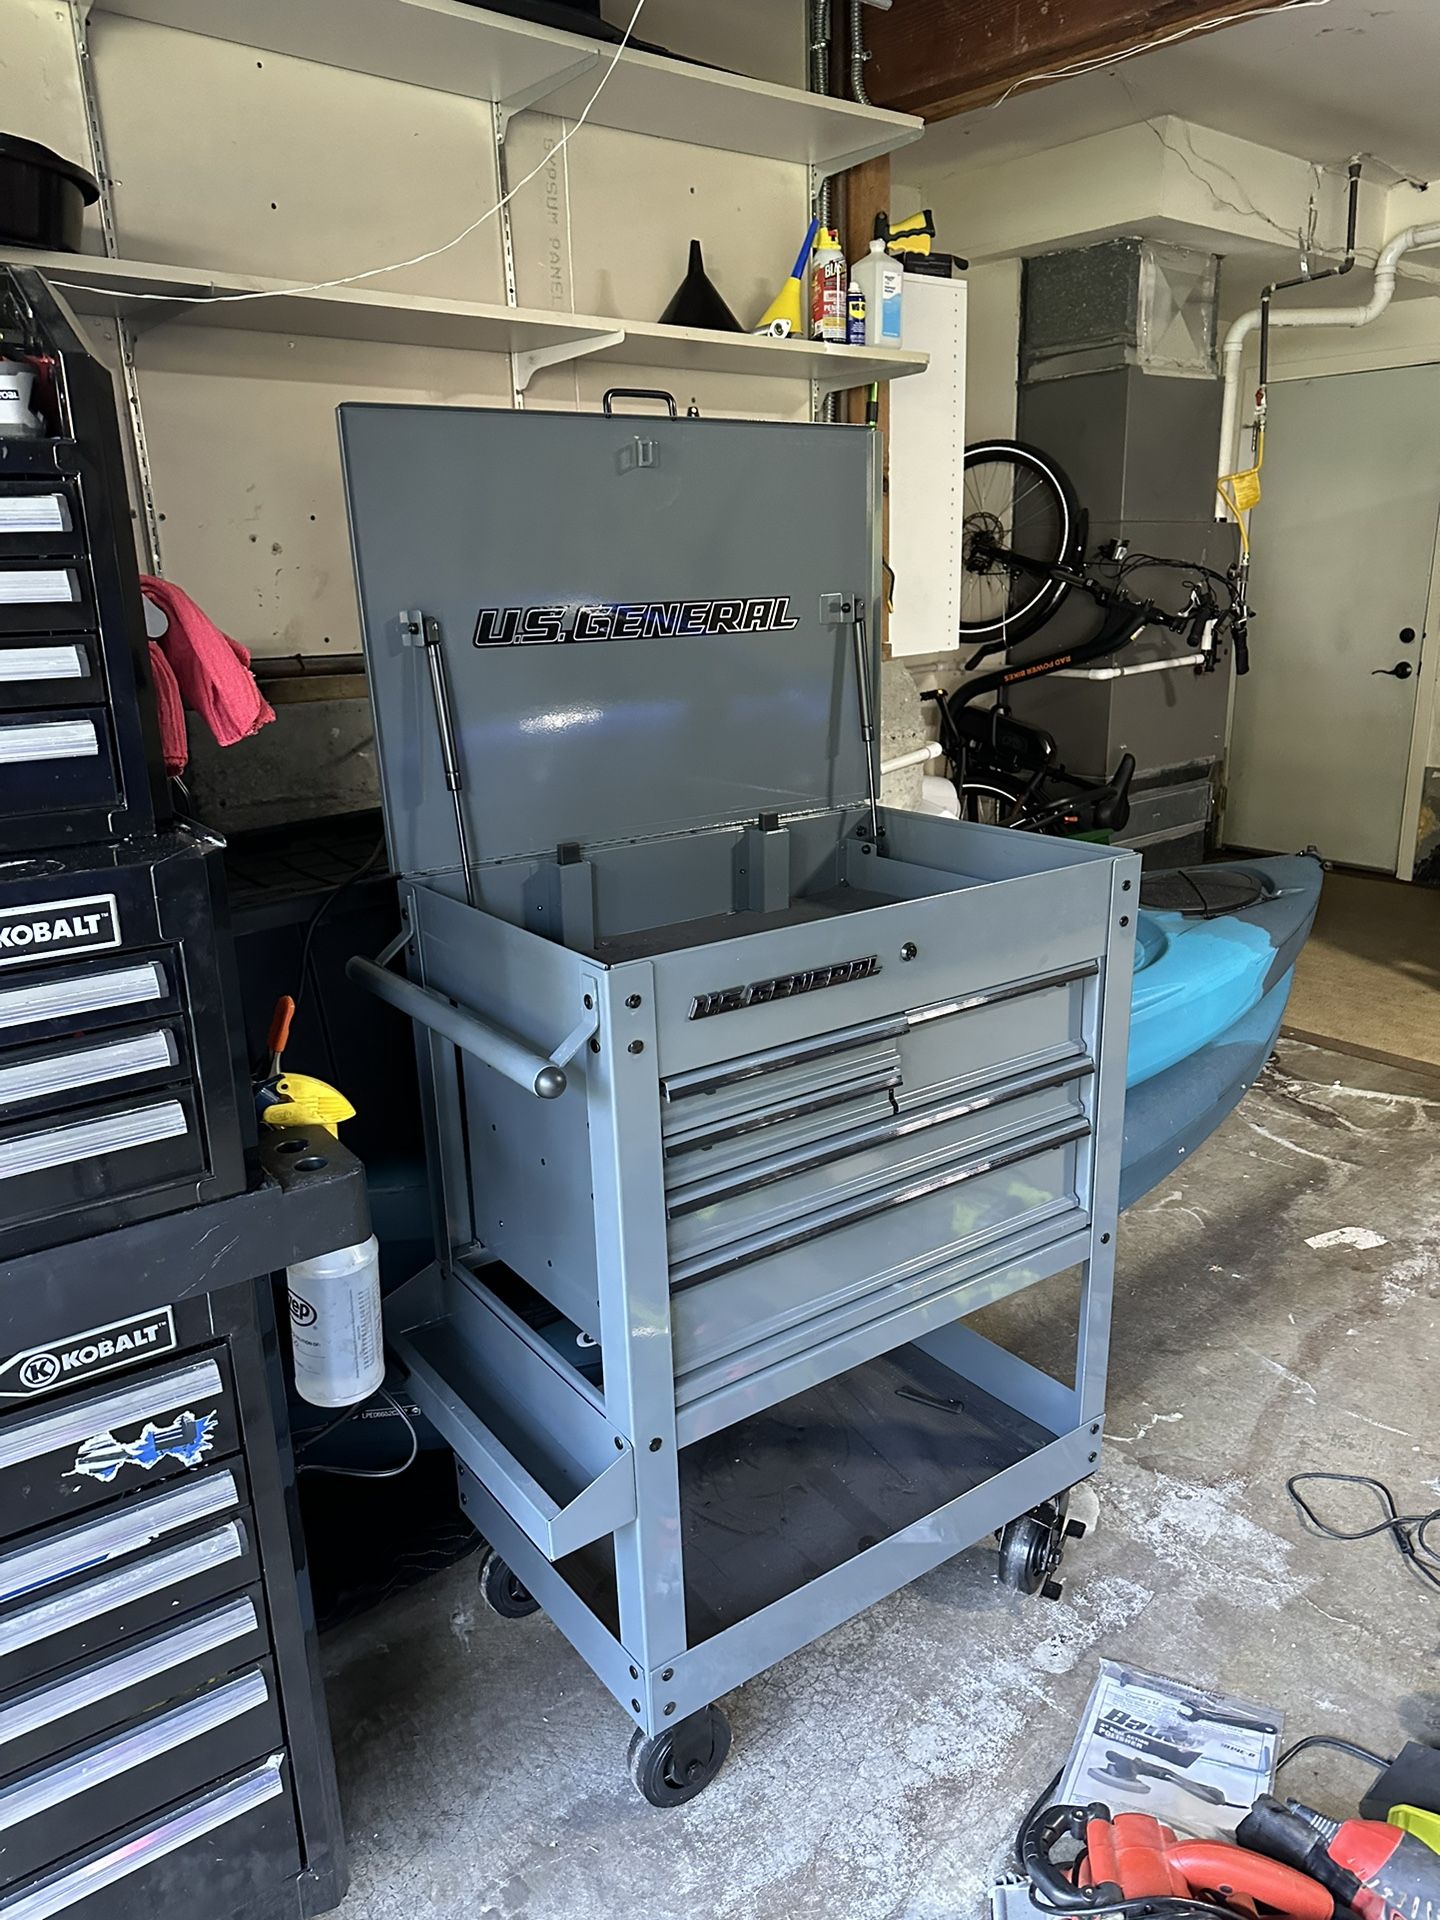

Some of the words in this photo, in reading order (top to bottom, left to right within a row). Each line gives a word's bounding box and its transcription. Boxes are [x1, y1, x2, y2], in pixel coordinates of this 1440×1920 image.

[549, 237, 564, 305] PANEL
[571, 596, 800, 641] GENERAL
[1004, 670, 1026, 682] BIKES
[1026, 661, 1054, 675] POWER
[1055, 655, 1071, 666] RAD
[746, 955, 883, 1006] GENERAL
[61, 1324, 159, 1371] KOBALT
[1098, 1727, 1143, 1749] POLISHER
